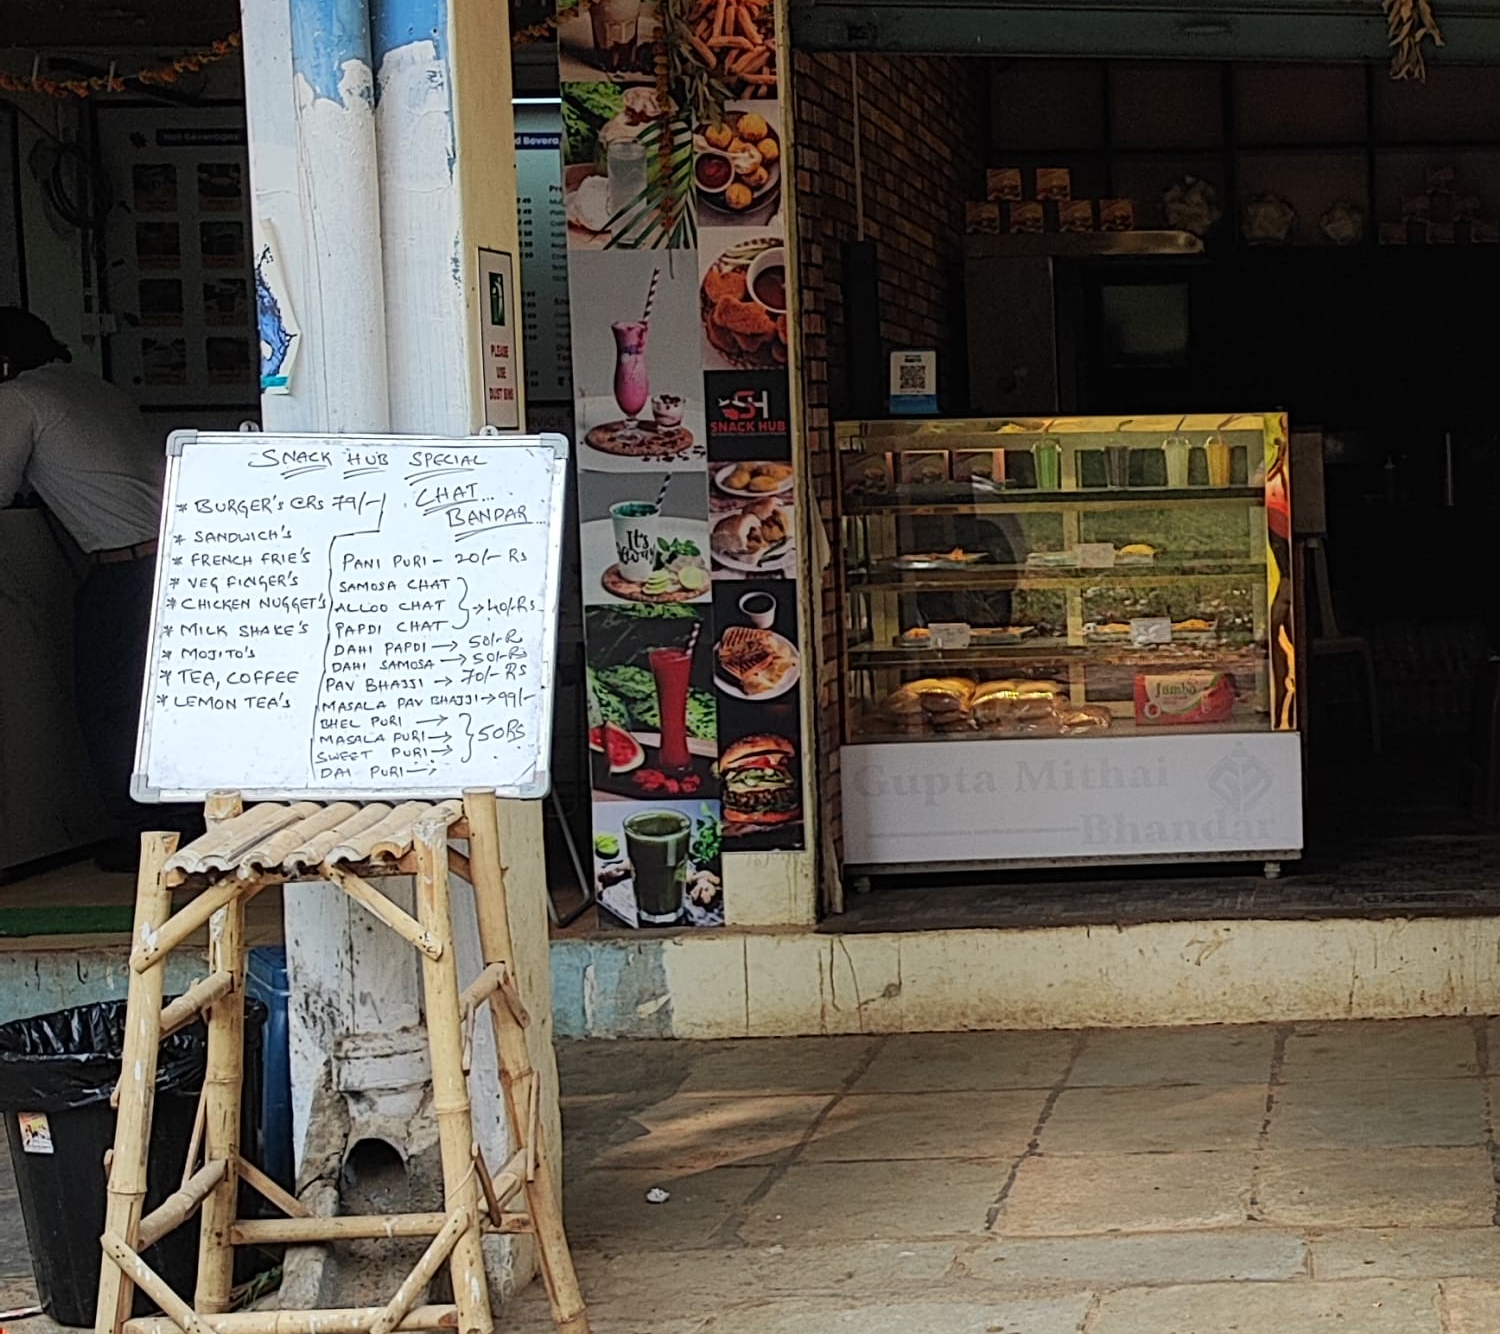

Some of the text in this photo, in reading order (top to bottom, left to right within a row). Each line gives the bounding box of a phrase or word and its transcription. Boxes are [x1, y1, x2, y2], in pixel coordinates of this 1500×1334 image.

[710, 420, 787, 433] SNACK HUB
[248, 449, 488, 468] SNACK HUB SPECIAL
[191, 553, 252, 567] FRENCH
[342, 554, 381, 571] PANI
[393, 555, 427, 568] PURI
[187, 577, 218, 593] VEG
[339, 579, 450, 593] SAMOSA CHAT
[181, 597, 250, 613] CHICKEN
[334, 599, 446, 613] ALLOO CHAT
[180, 623, 228, 637] MILK
[335, 620, 449, 639] PAPDI CHAT
[333, 644, 372, 656] DAHI
[384, 642, 426, 656] PAPDI
[332, 662, 366, 673] DAHI
[380, 659, 435, 671] SAMOSA
[178, 669, 299, 690] TEA, COFFEE
[326, 678, 355, 692] PAV
[174, 696, 237, 710] LEMON
[322, 700, 387, 713] MASALA
[397, 697, 423, 710] PAV
[320, 715, 402, 729] BHEL PURI
[319, 730, 425, 746] MASALA PURI
[315, 747, 428, 764] SWEET PURI
[370, 765, 404, 779] PURI
[855, 756, 1170, 807] Gupta Mithai
[1079, 810, 1277, 849] Bhandar
